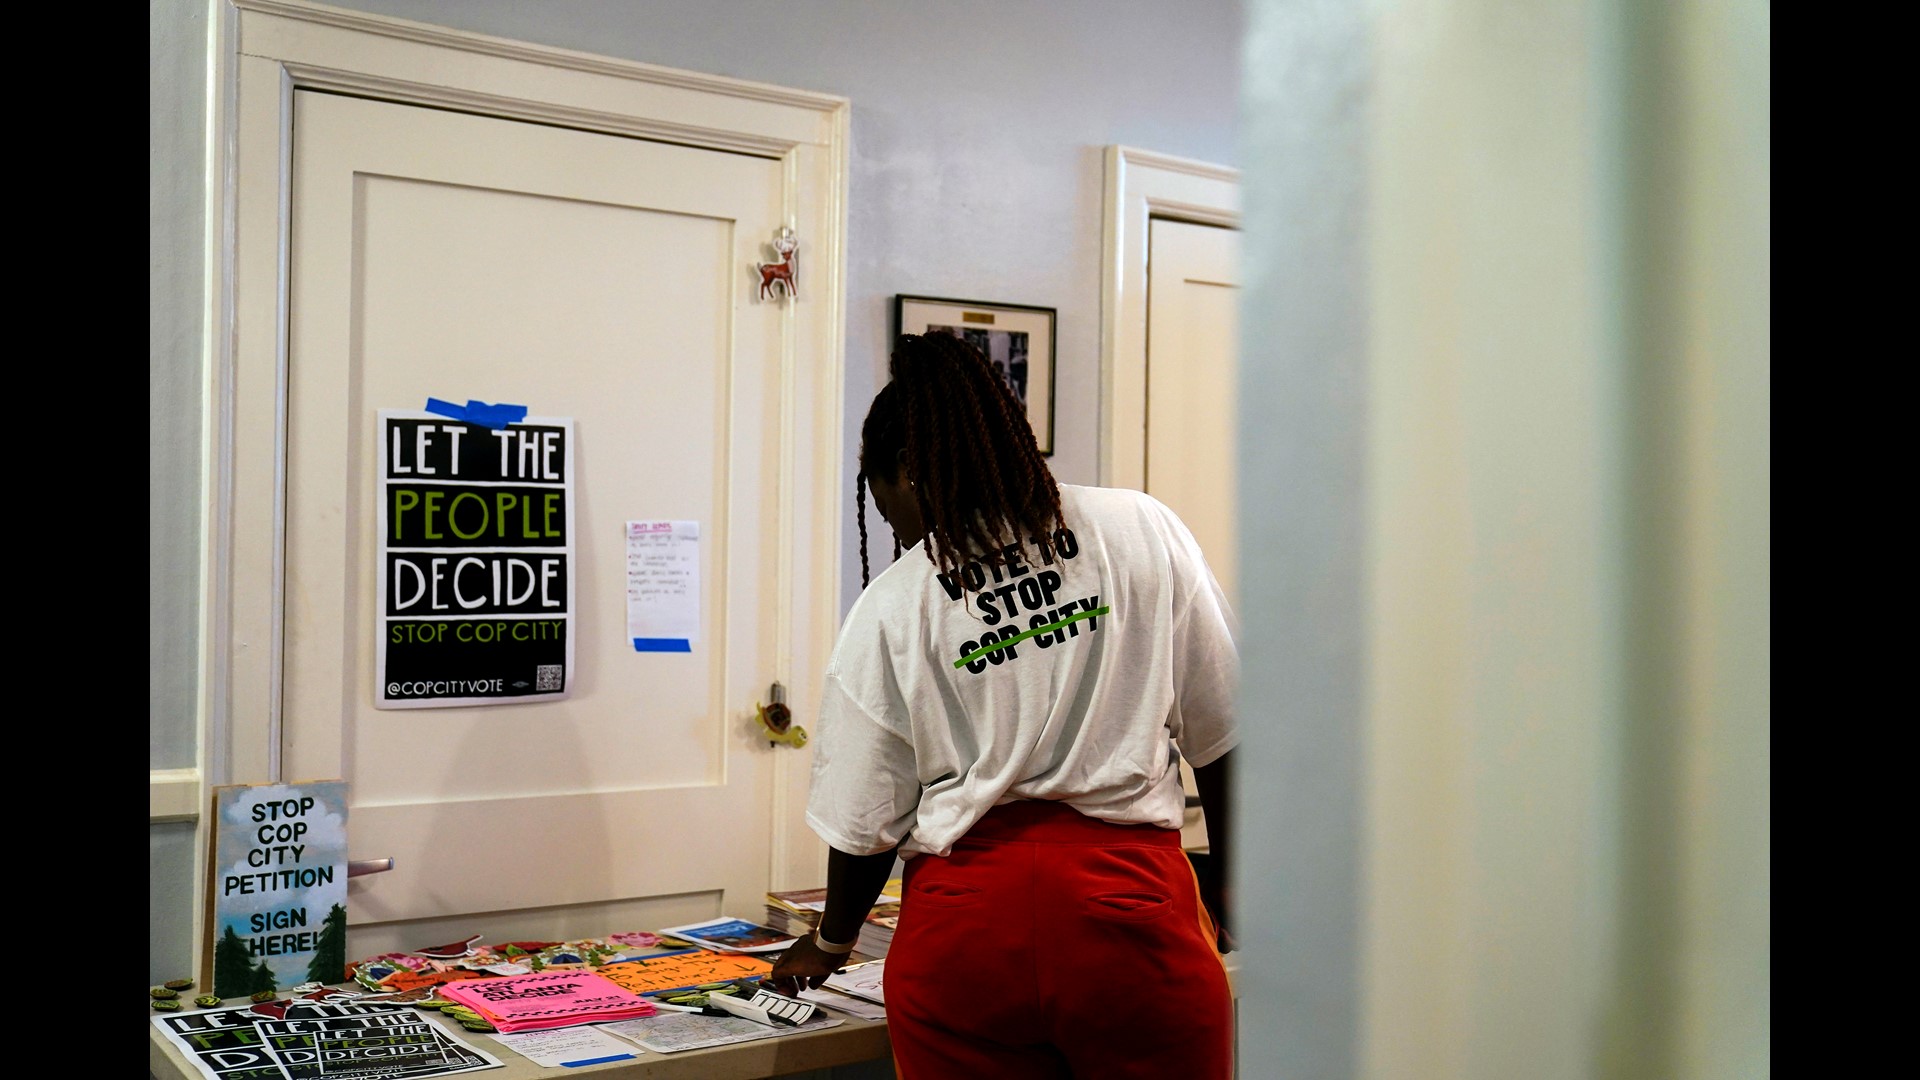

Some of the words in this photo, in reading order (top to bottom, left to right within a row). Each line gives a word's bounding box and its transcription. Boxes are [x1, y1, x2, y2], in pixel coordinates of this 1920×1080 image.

[393, 425, 467, 475] LET
[491, 430, 560, 480] THE
[395, 490, 561, 540] PEOPLE
[1029, 528, 1079, 566] TO
[395, 557, 561, 610] DECIDE
[976, 570, 1061, 625] STOP
[391, 623, 448, 643] STOP
[456, 622, 507, 643] COP
[512, 621, 563, 641] CITY
[959, 624, 1021, 674] COP
[1029, 595, 1099, 649] CITY
[387, 679, 503, 696] @COPCITYVOTE
[252, 797, 314, 822] STOP
[257, 822, 308, 845] COP
[247, 844, 305, 868] CITY
[225, 865, 334, 896] PETITION
[250, 907, 307, 933] SIGN
[249, 931, 318, 957] HERE!
[473, 985, 515, 994] LET
[483, 983, 583, 998] ATLANTA
[487, 988, 577, 1002] DECIDE
[265, 1020, 329, 1035] LET
[351, 1013, 418, 1028] THE
[320, 1029, 367, 1040] LET
[382, 1025, 431, 1036] THE
[323, 1035, 433, 1049] PEOPLE
[325, 1044, 437, 1060] DECIDE
